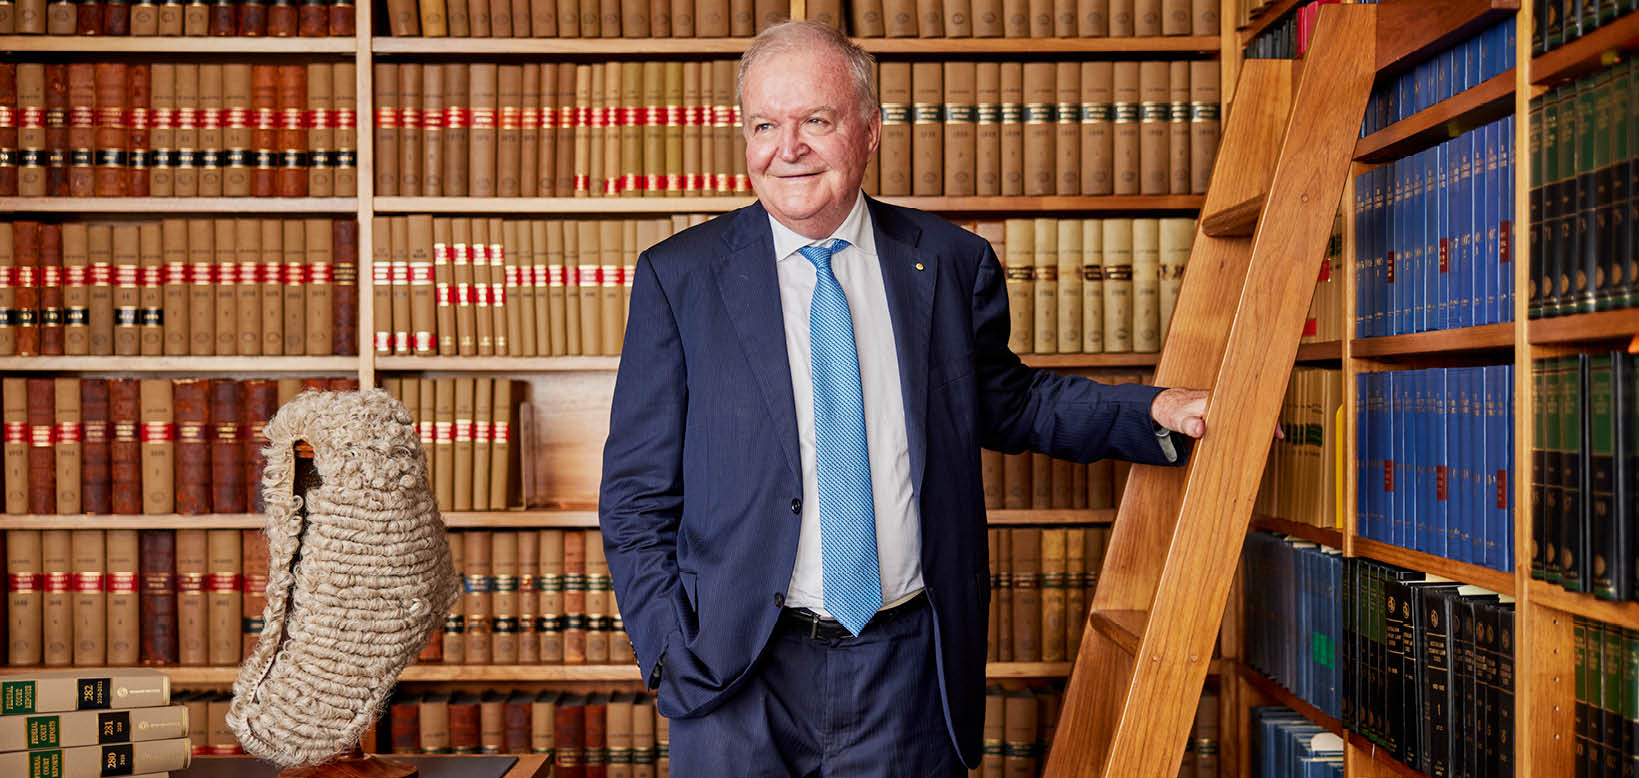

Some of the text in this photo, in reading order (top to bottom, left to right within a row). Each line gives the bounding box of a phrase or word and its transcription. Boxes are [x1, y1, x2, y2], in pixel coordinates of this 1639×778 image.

[6, 686, 14, 710] FEDERAL
[15, 688, 23, 706] COURT
[24, 685, 32, 709] REPORTS
[84, 684, 94, 702] 282
[31, 721, 39, 745] FEDERAL
[104, 720, 113, 736] 281
[107, 752, 116, 769] 280
